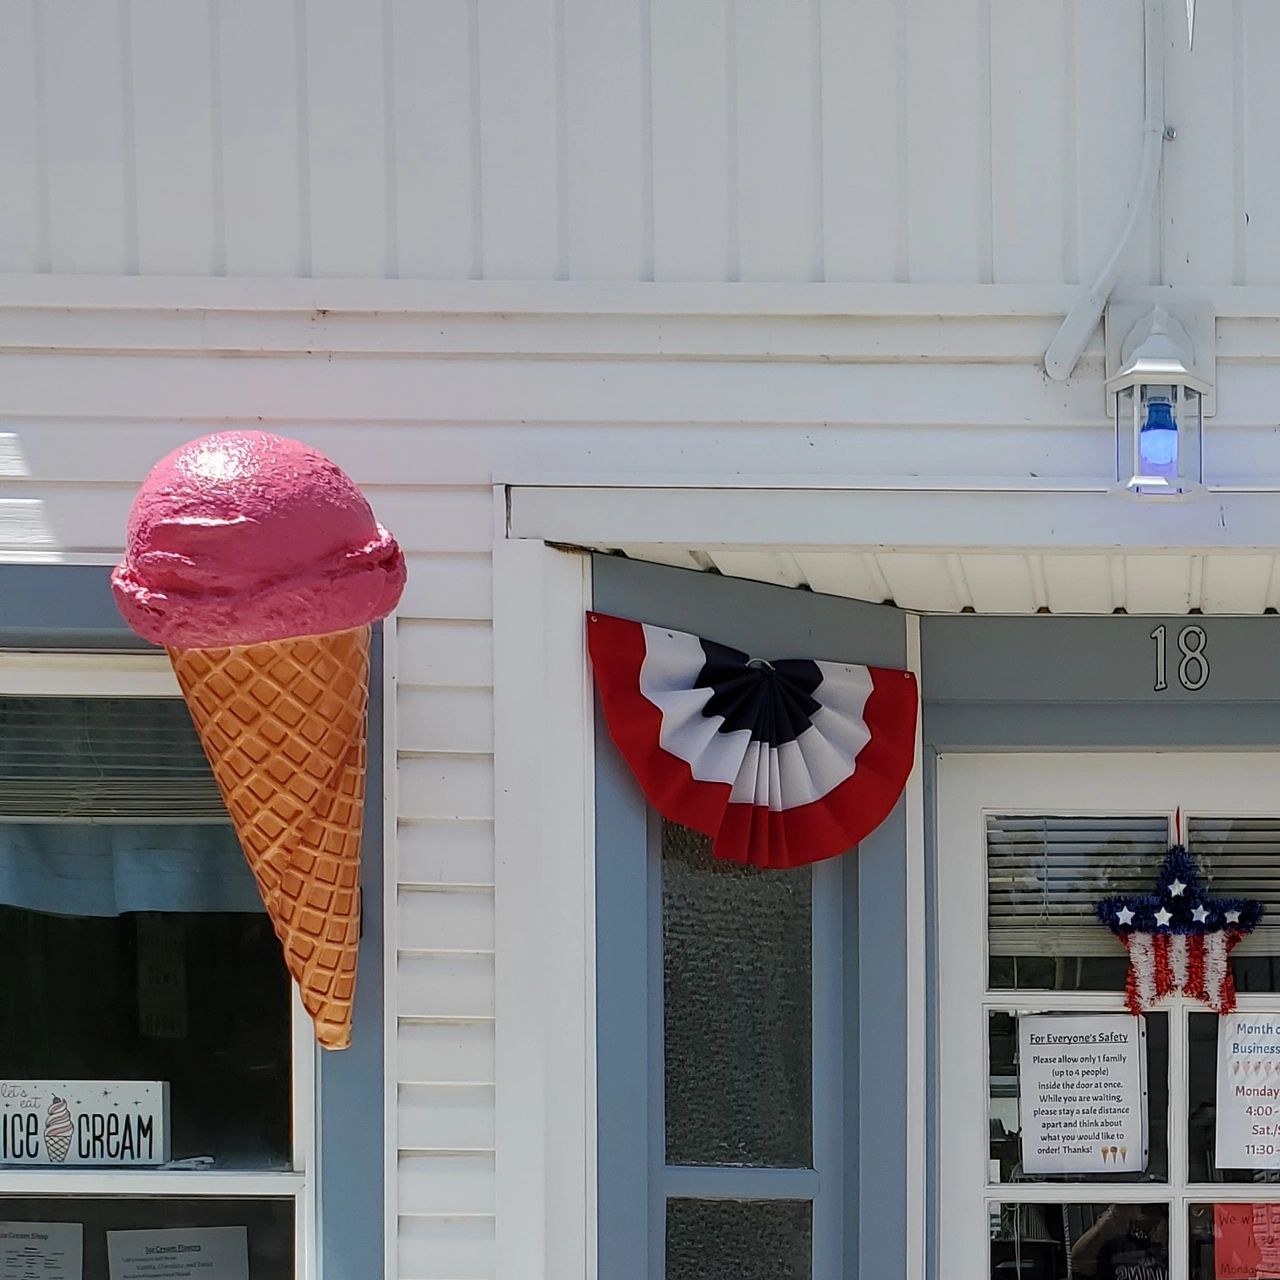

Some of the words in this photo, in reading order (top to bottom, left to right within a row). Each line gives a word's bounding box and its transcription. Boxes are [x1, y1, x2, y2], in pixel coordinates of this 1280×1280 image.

[1150, 624, 1210, 691] 18
[1236, 1024, 1273, 1035] Month
[1030, 1034, 1045, 1044] For
[1047, 1034, 1097, 1045] Everyone's
[1099, 1032, 1128, 1044] Safety
[1232, 1043, 1280, 1054] Business
[1033, 1056, 1056, 1064] Please
[1058, 1055, 1078, 1063] allow
[1080, 1055, 1096, 1064] only
[1102, 1054, 1126, 1064] family
[1052, 1068, 1064, 1078] (up
[1082, 1068, 1109, 1078] people)
[1038, 1082, 1061, 1090] inside
[20, 1096, 43, 1109] eat
[1039, 1094, 1062, 1103] While
[1063, 1095, 1077, 1103] you
[1033, 1108, 1057, 1117] please
[1058, 1108, 1074, 1117] stay
[1082, 1107, 1098, 1115] safe
[1098, 1106, 1130, 1115] distance
[1246, 1106, 1273, 1117] 4:00
[1041, 1121, 1062, 1130] apart
[1079, 1120, 1100, 1128] think
[1040, 1134, 1061, 1142] what
[1062, 1135, 1076, 1143] you
[1077, 1133, 1100, 1141] would
[1101, 1132, 1115, 1140] like
[1037, 1146, 1060, 1154] order!
[1062, 1146, 1093, 1154] Thanks!
[1245, 1145, 1274, 1155] 11:30
[1218, 1213, 1237, 1225] We
[1221, 1263, 1259, 1275] Monda
